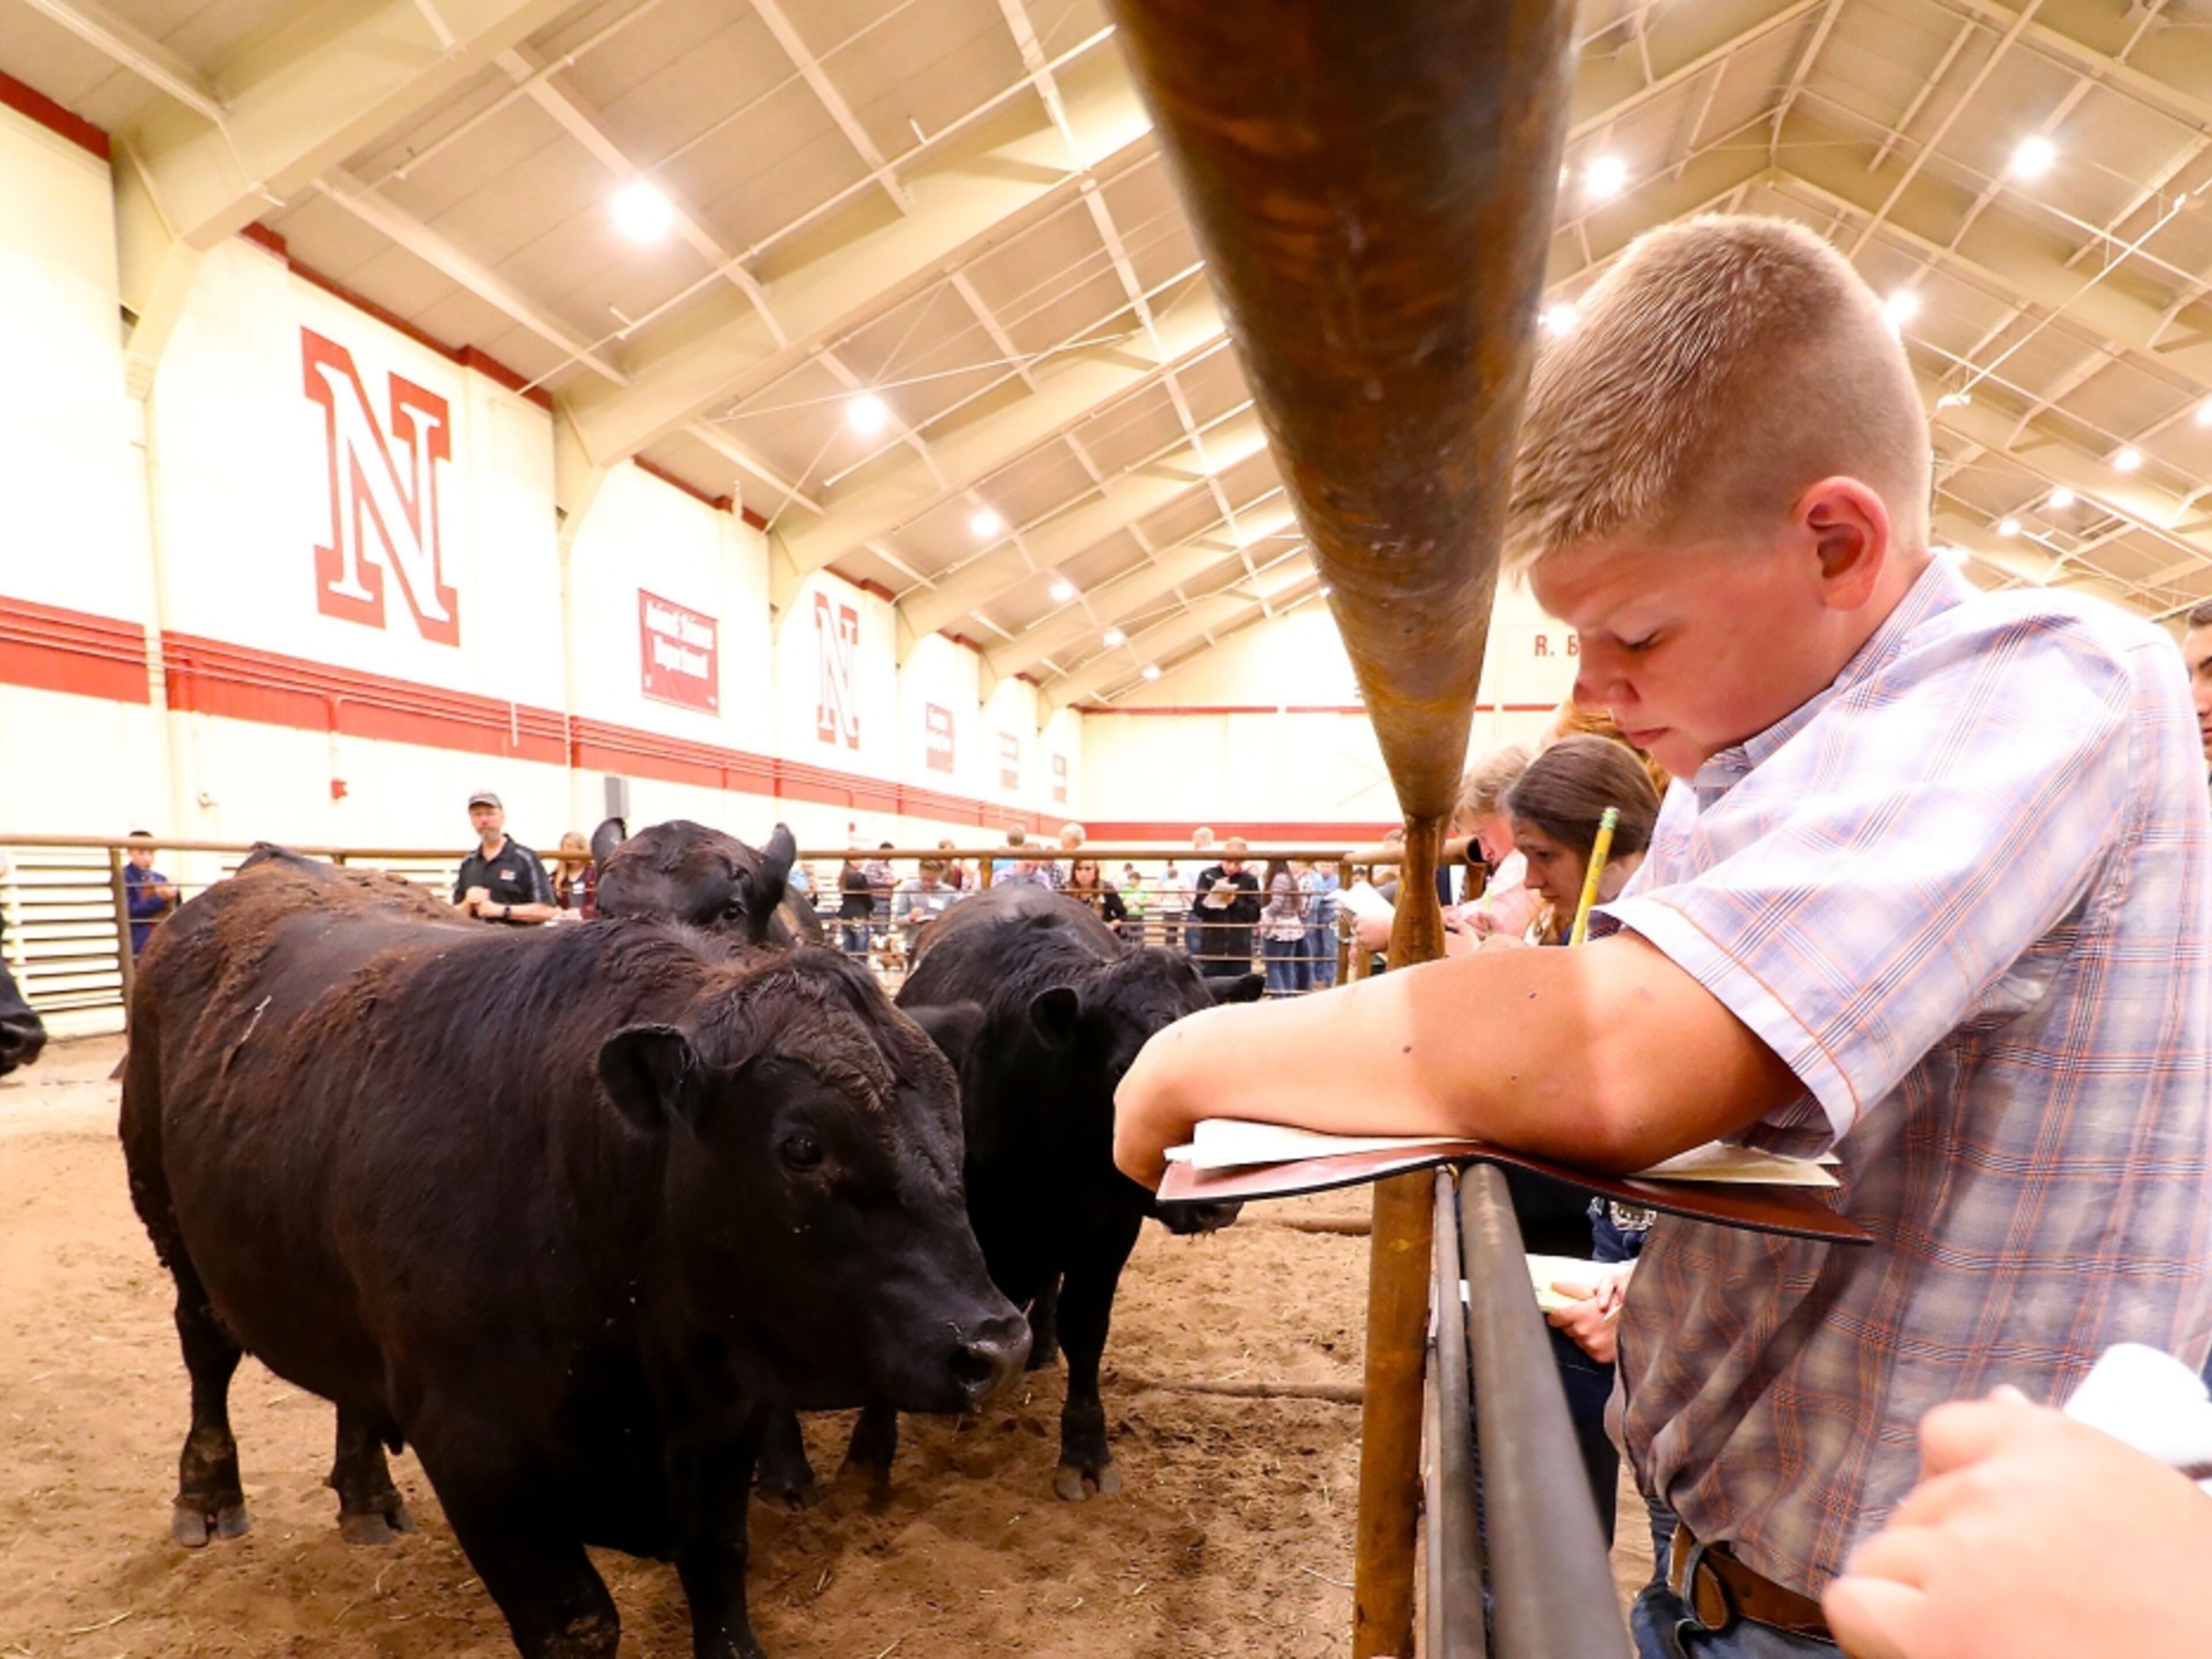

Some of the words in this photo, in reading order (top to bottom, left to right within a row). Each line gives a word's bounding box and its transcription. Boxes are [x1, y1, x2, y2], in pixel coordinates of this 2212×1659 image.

[300, 325, 460, 648] N
[815, 591, 859, 750] N
[1535, 634, 1555, 657] R.
